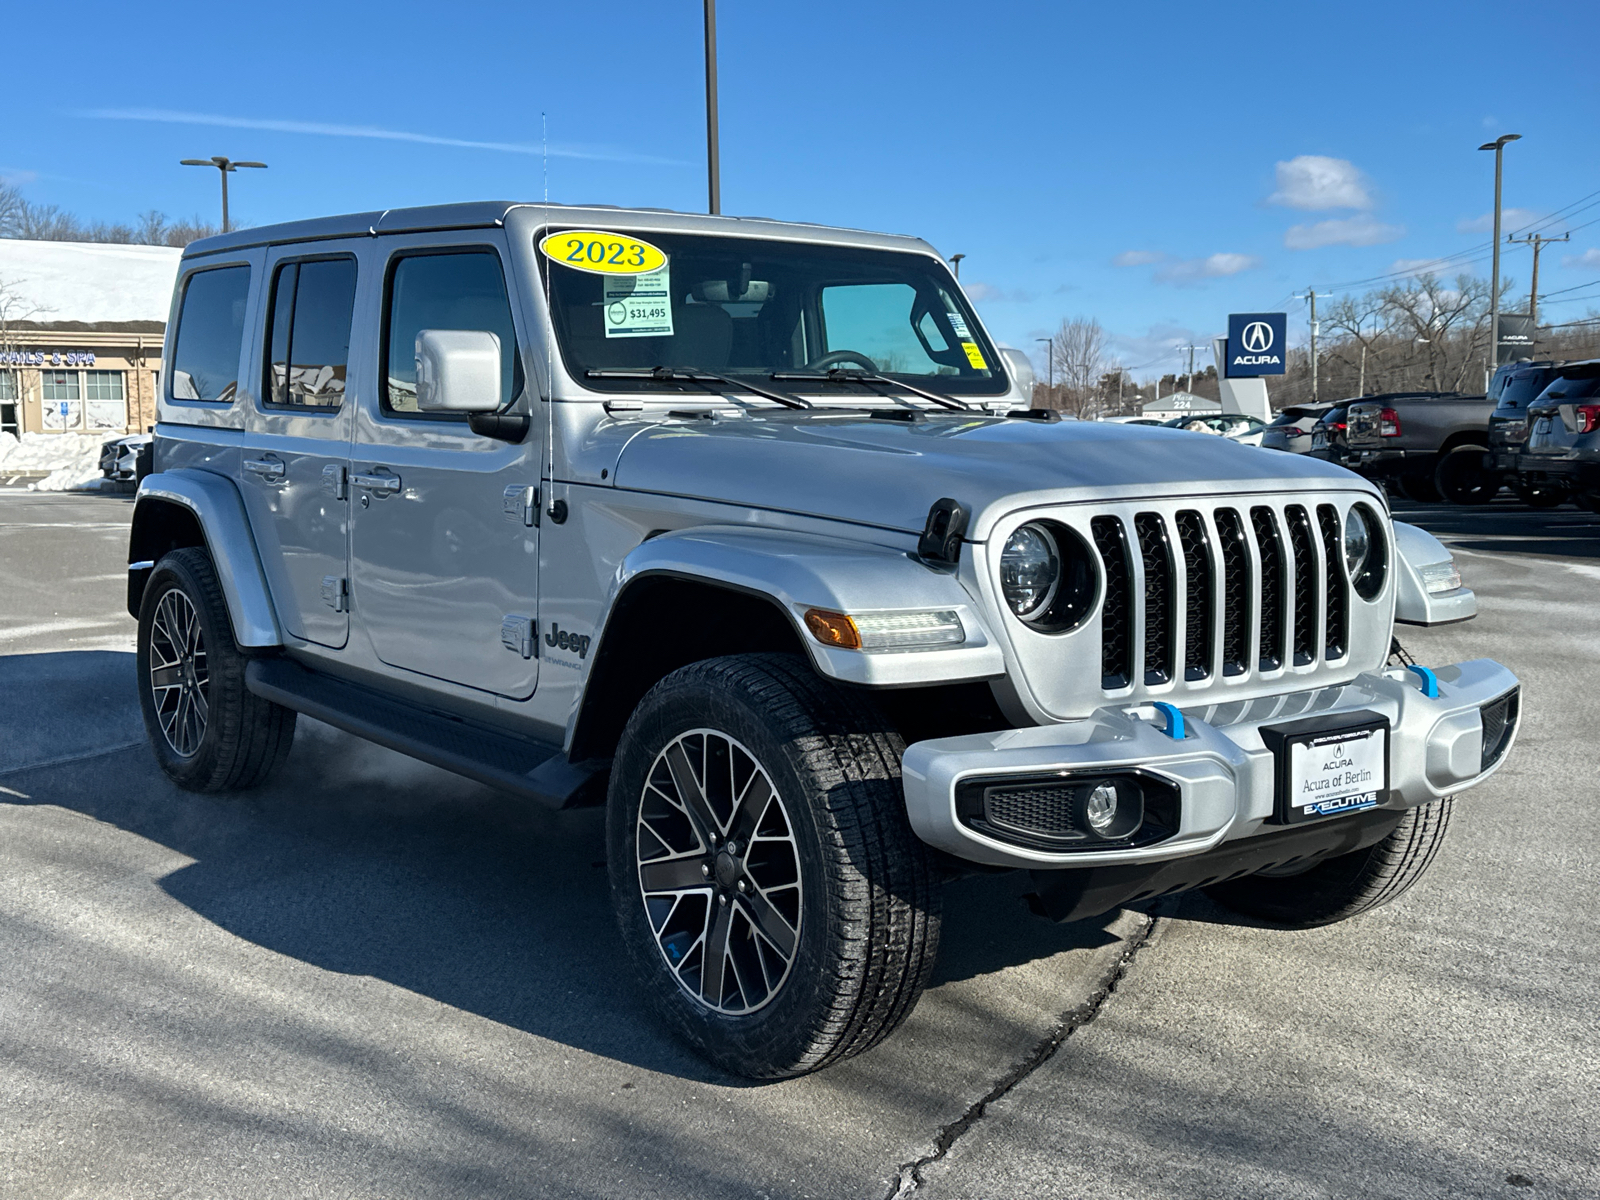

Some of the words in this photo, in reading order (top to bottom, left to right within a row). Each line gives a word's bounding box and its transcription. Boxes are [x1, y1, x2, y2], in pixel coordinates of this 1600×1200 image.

[566, 239, 645, 266] 2023
[630, 309, 666, 320] $31,495
[52, 351, 61, 364] &
[66, 351, 96, 364] SPA
[1233, 355, 1281, 365] ACURA
[1173, 401, 1191, 409] 224
[545, 622, 591, 659] Jeep
[1322, 758, 1354, 771] ACURA
[1303, 779, 1330, 793] Acura
[1332, 774, 1342, 787] of
[1345, 768, 1372, 785] Berlin
[1303, 791, 1377, 815] EXECUTIVE
